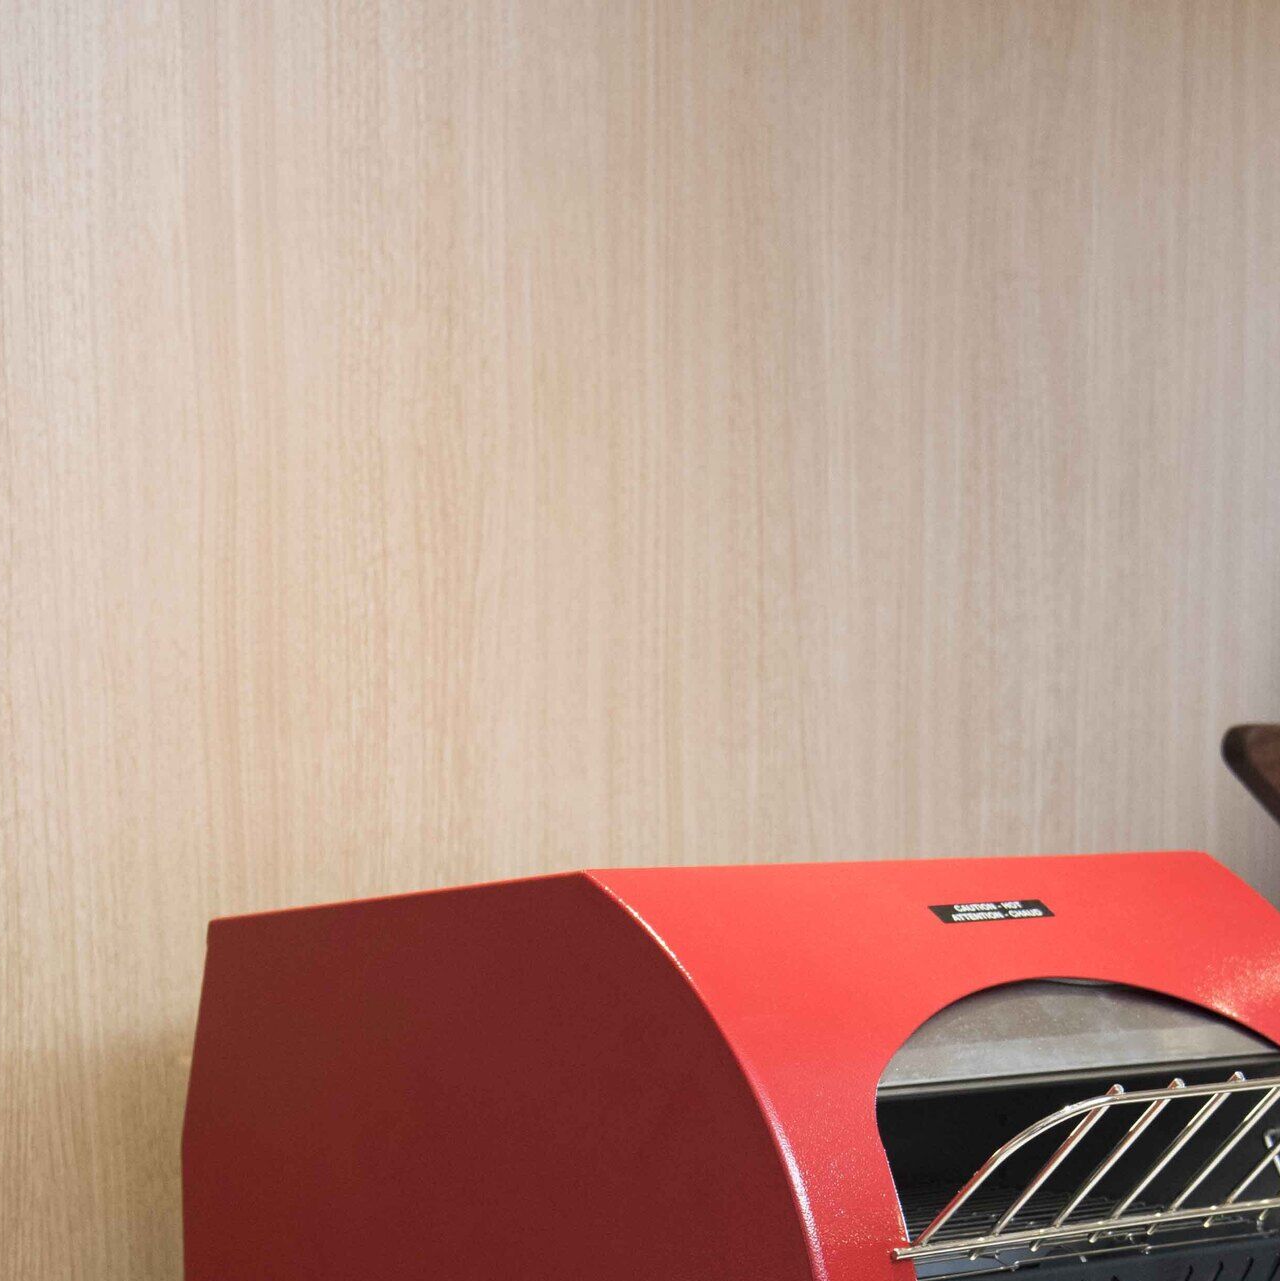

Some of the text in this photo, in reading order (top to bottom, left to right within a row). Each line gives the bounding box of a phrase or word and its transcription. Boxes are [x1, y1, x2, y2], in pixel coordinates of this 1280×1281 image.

[953, 903, 997, 912] CAUTION
[1001, 901, 1022, 909] HOT
[952, 911, 1004, 922] ATTENTION
